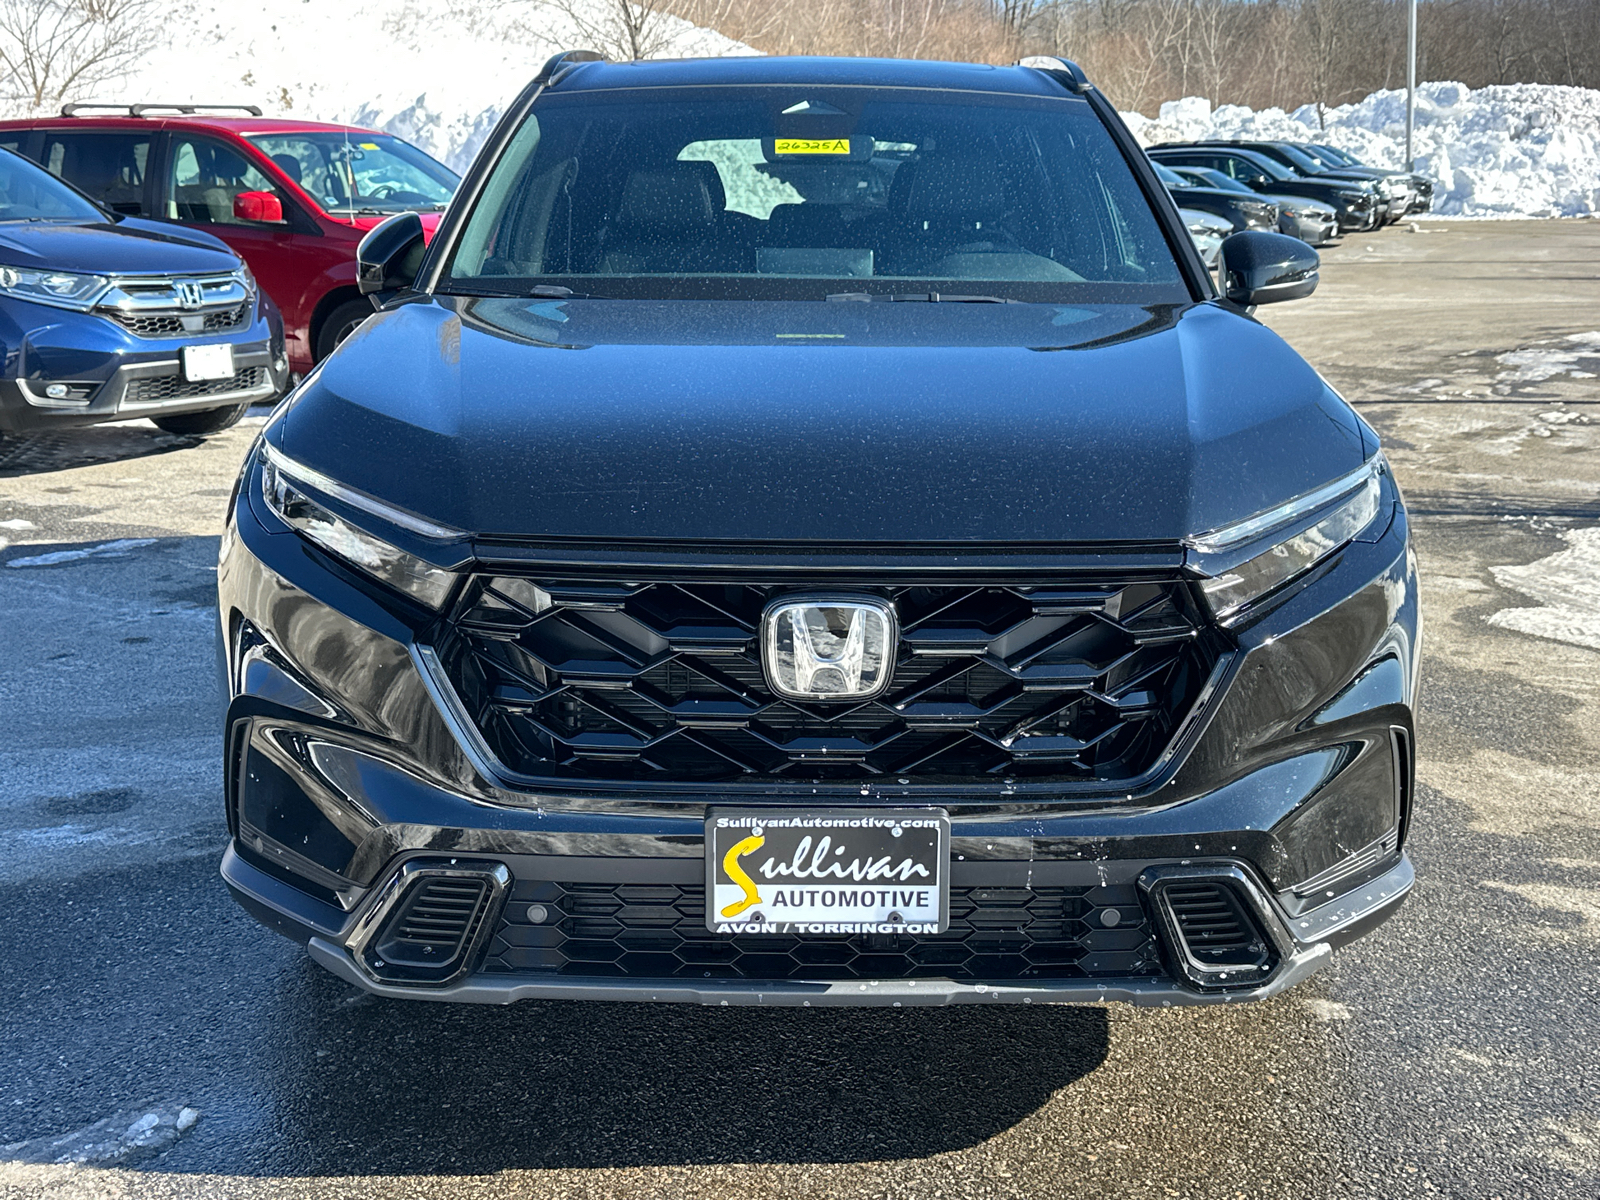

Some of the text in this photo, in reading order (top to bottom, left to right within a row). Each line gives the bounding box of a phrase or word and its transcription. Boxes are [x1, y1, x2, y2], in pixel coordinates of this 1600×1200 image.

[777, 140, 848, 152] 26325A
[716, 817, 940, 829] SullivanAutomotive.com
[721, 835, 930, 918] Sullivan
[771, 890, 929, 908] AUTOMOTIVE
[716, 923, 777, 934] AVON
[800, 923, 939, 934] TORRINGTON
